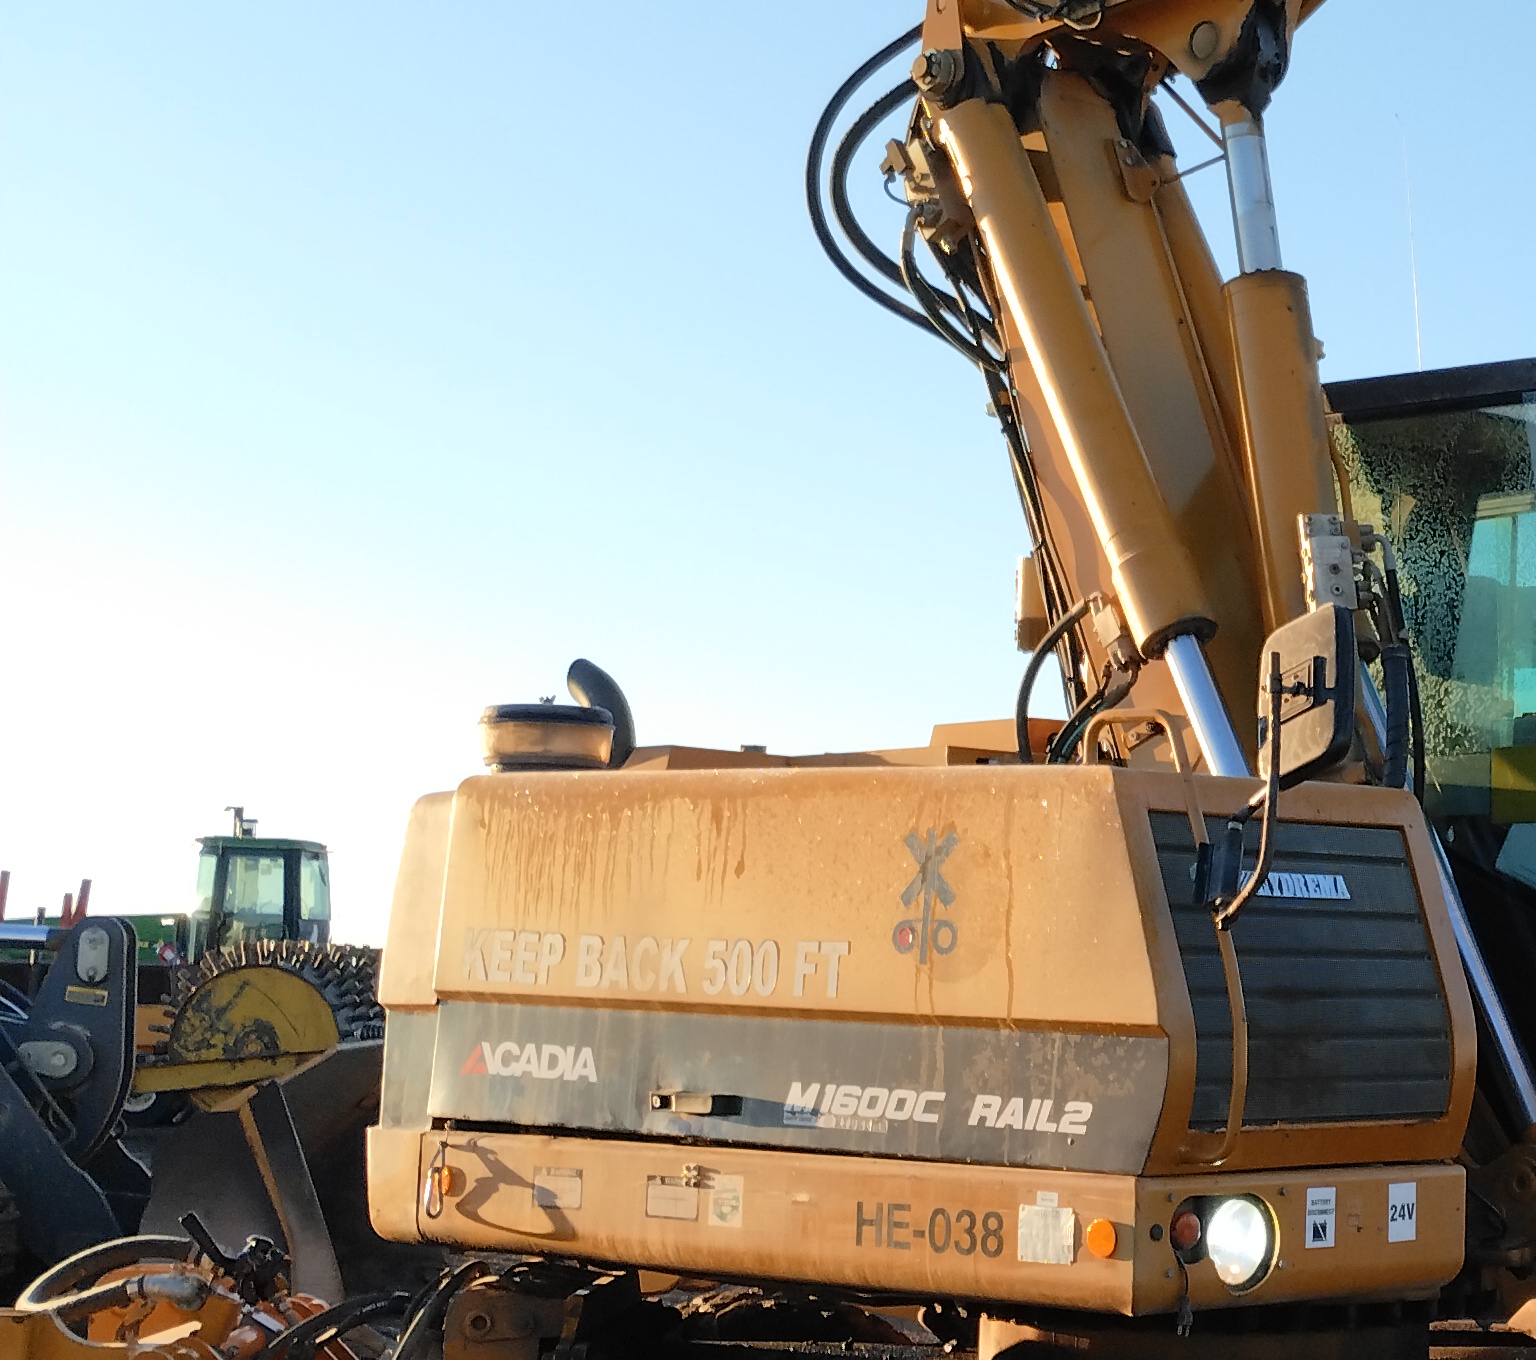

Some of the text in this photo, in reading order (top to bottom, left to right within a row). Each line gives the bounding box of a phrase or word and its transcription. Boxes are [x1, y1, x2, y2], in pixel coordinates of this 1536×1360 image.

[461, 928, 851, 999] KEEP BACK 500 FT
[460, 1041, 598, 1083] ACADIA
[785, 1081, 1093, 1135] M1600C RAIL2
[856, 1201, 1004, 1258] HE-038
[1390, 1203, 1415, 1222] 24V
